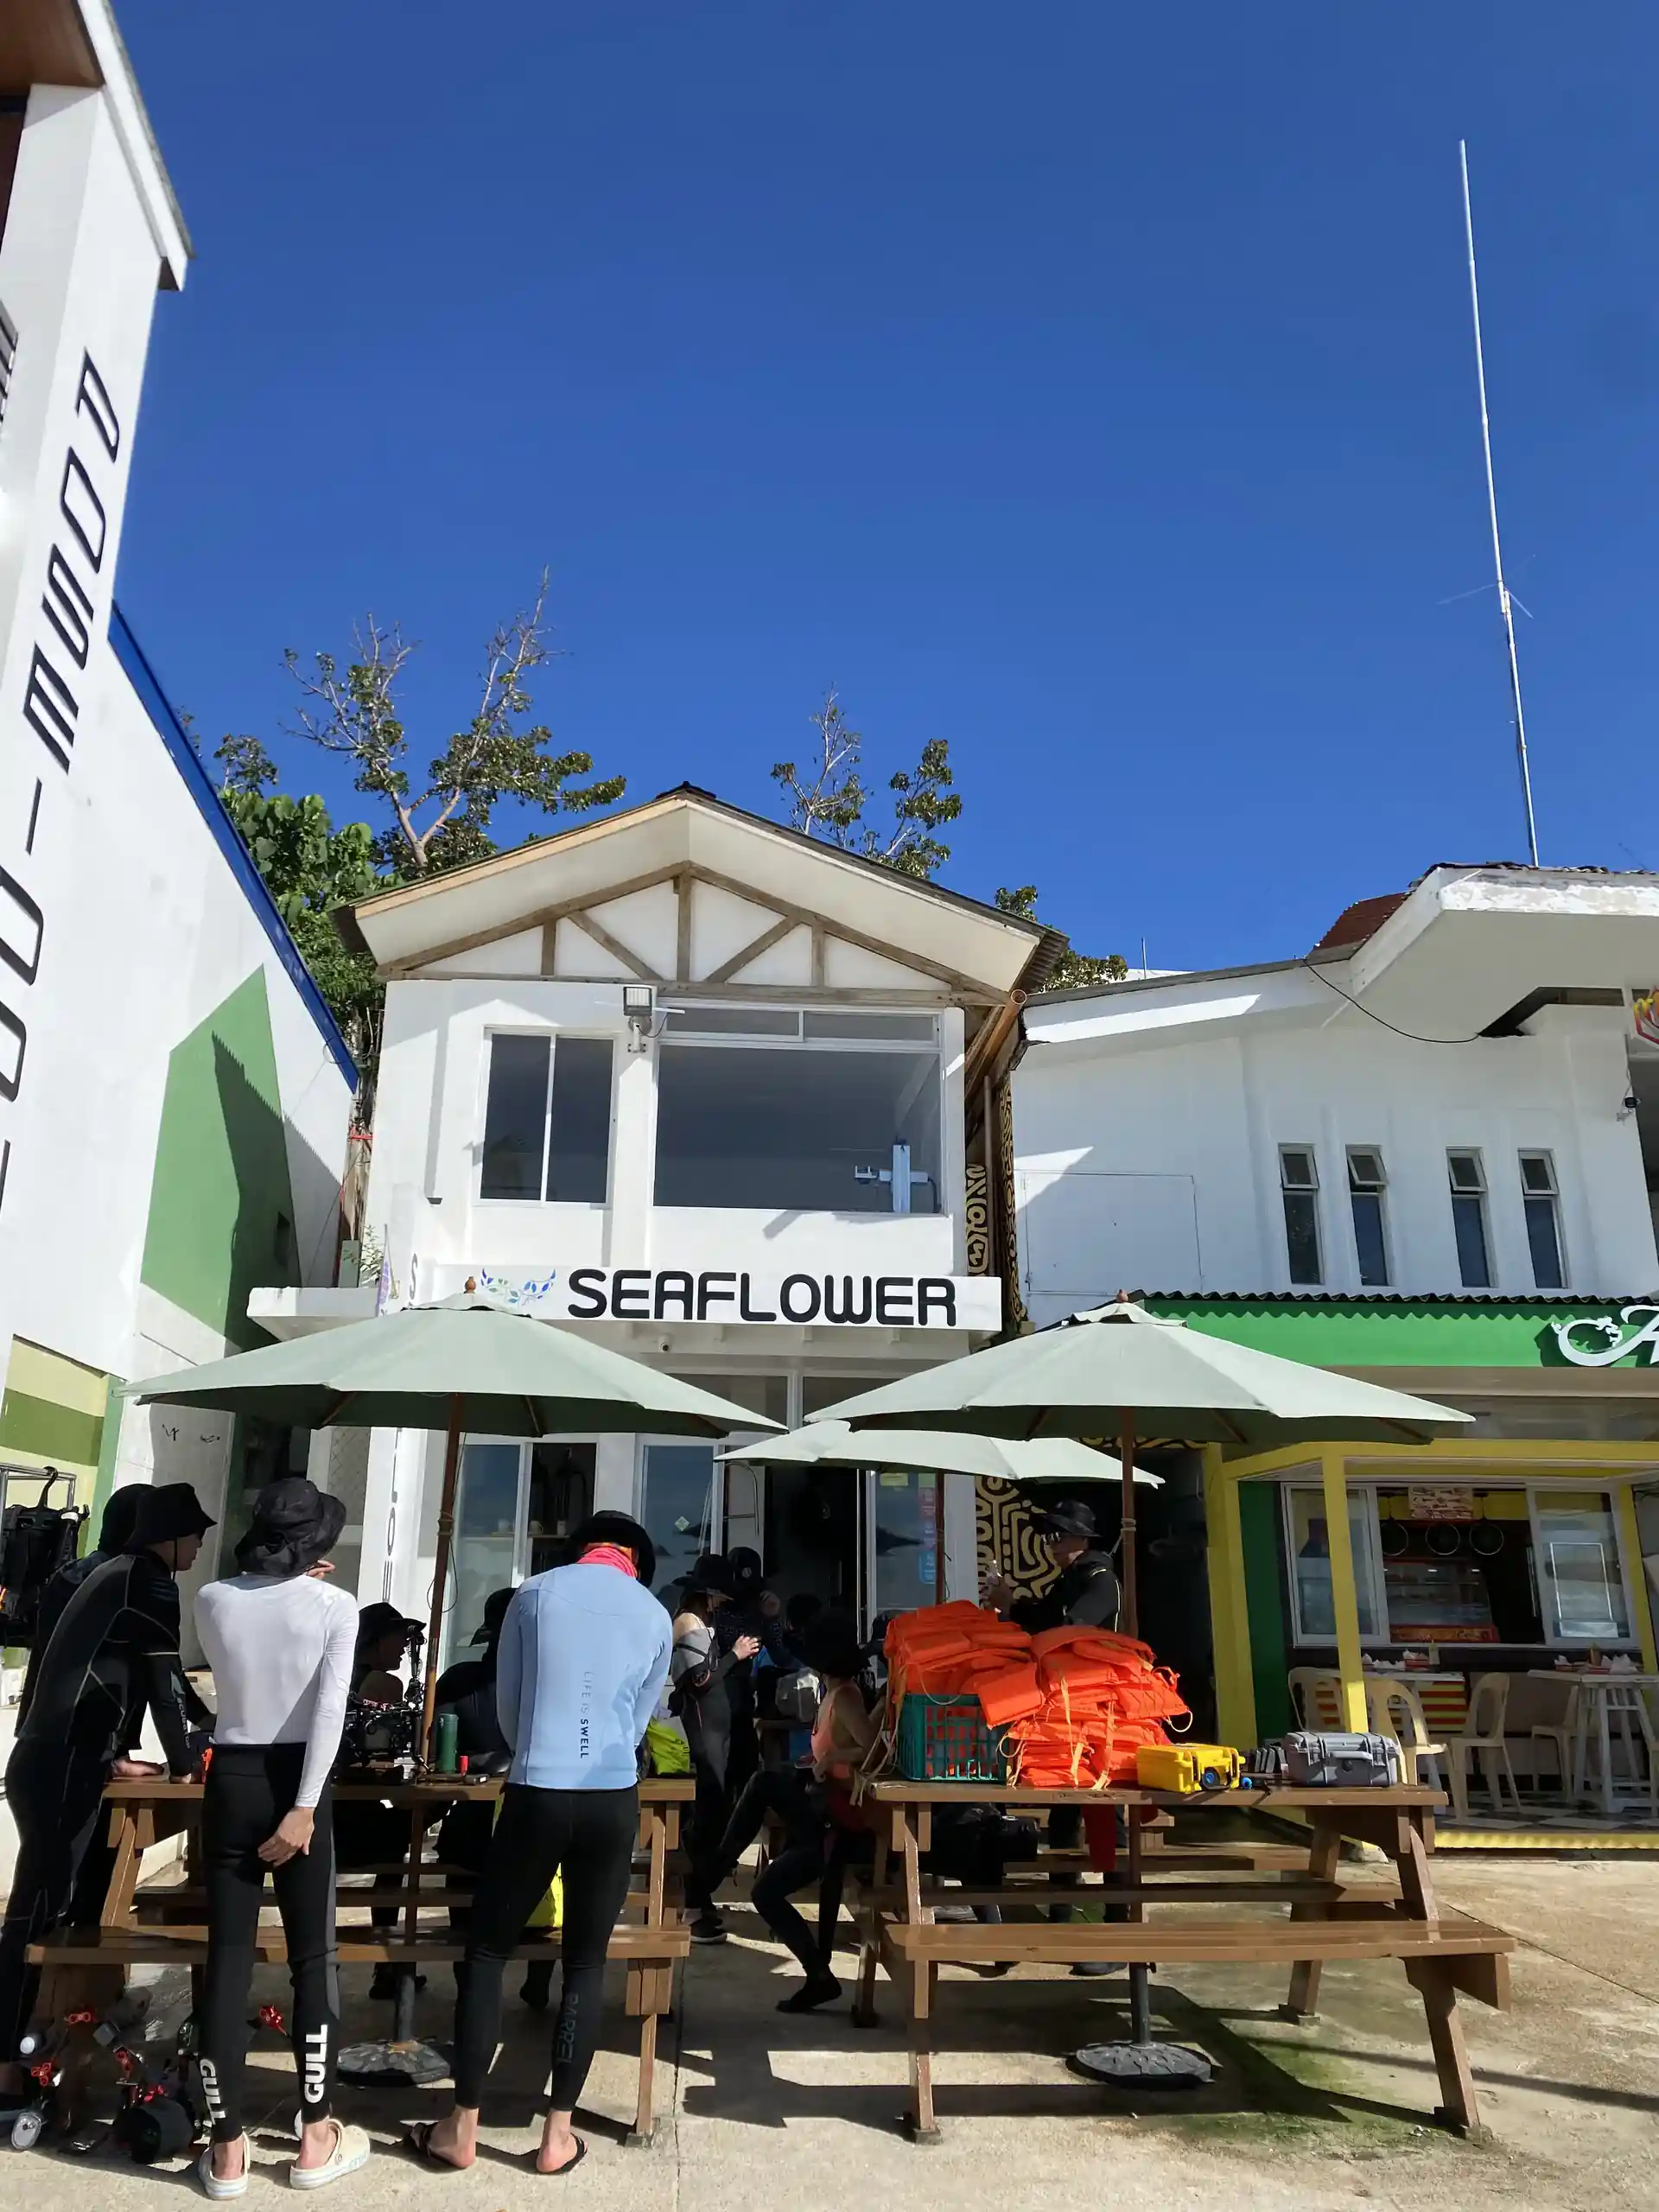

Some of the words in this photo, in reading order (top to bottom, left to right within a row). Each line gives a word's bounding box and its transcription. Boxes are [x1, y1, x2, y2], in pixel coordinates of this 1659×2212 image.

[568, 1267, 957, 1328] SEAFLOWER
[580, 1719, 589, 1759] SWELL
[581, 1703, 589, 1714] IS
[200, 2058, 226, 2125] GULL
[304, 2024, 328, 2104] GULL
